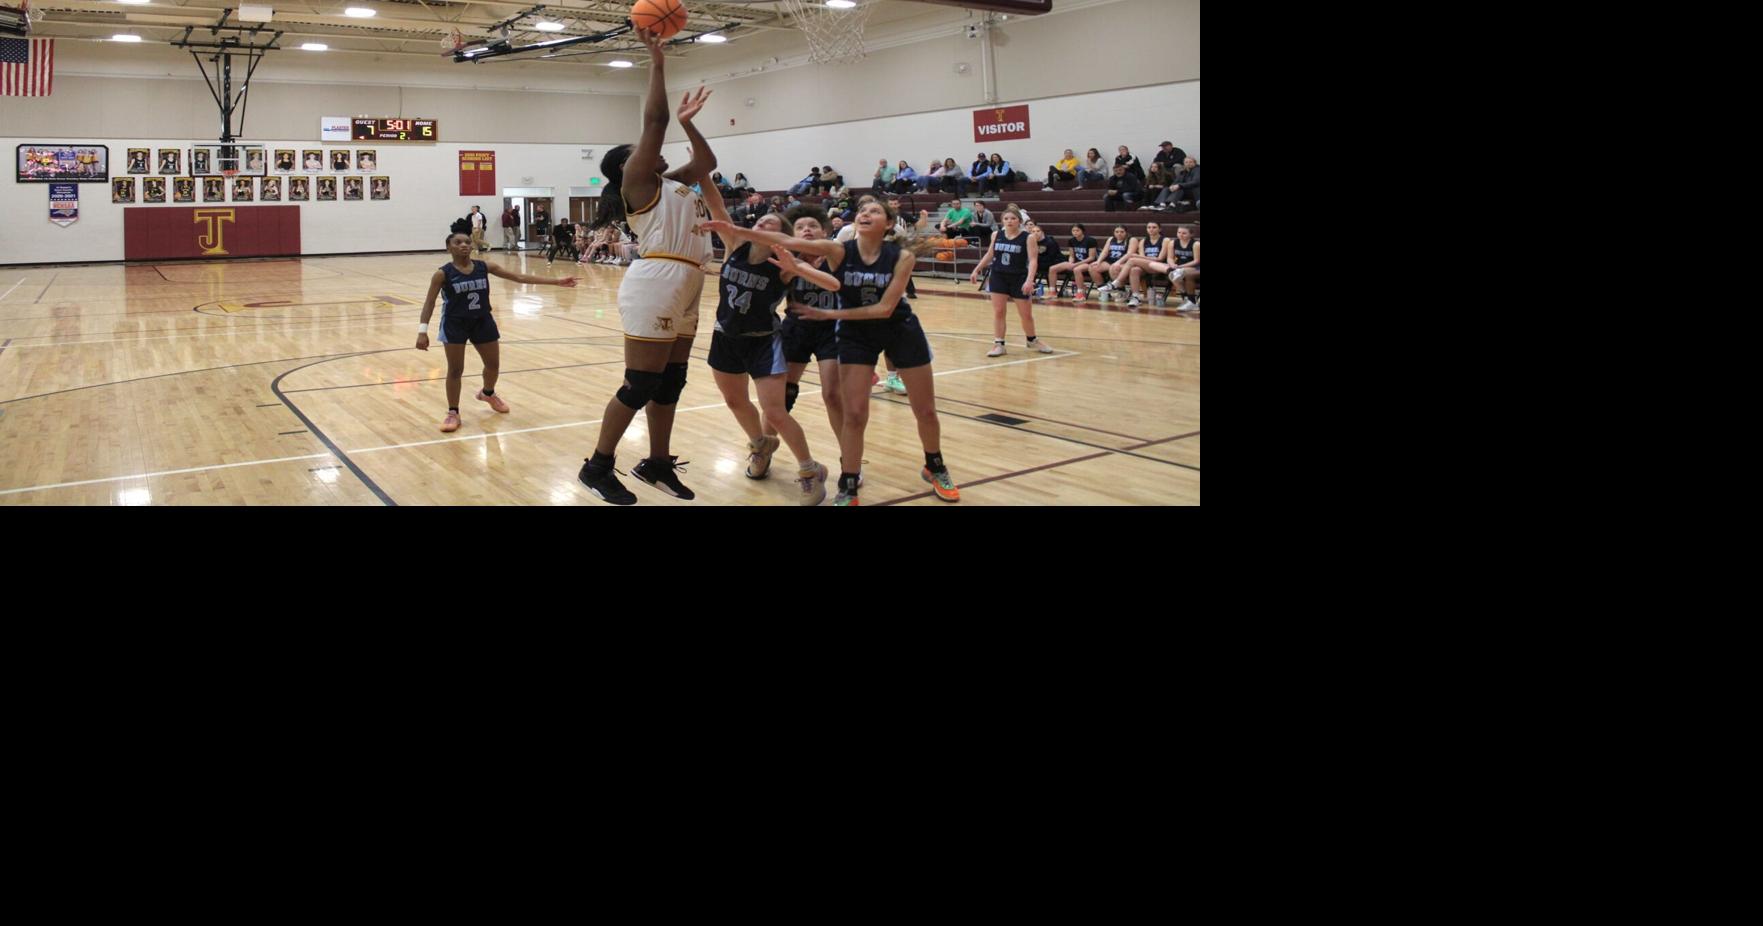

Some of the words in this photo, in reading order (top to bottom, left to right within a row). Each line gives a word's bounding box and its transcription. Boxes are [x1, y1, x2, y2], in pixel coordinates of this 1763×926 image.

[366, 125, 374, 136] 7
[421, 126, 433, 137] 15
[386, 119, 411, 131] 5:01
[978, 122, 1025, 135] VISITOR
[399, 132, 406, 140] 2
[467, 292, 481, 310] 2
[726, 284, 753, 315] 24
[804, 292, 834, 310] 20
[861, 287, 878, 305] 5
